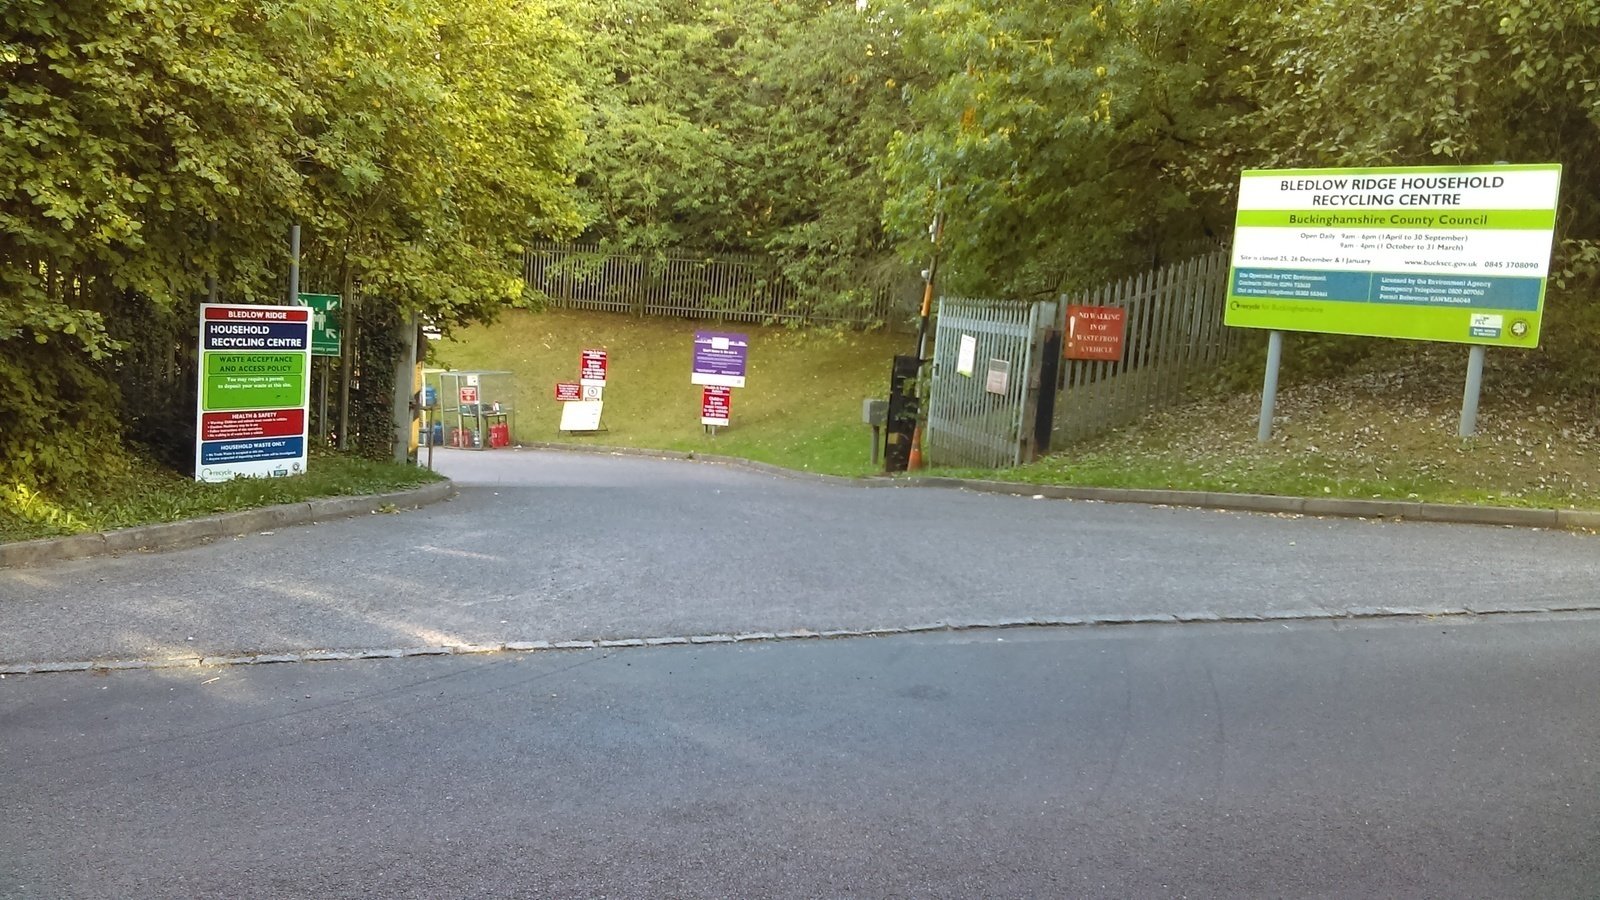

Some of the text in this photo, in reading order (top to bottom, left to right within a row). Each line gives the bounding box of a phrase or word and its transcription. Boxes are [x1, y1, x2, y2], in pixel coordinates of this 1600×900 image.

[1280, 176, 1504, 191] BLEDLOW RIDGE HOUSEHOLD
[1312, 193, 1461, 206] RECYCLING CENTRE
[1289, 214, 1488, 227] Buckinghamshire County Council
[1300, 232, 1318, 240] Open
[1424, 234, 1469, 242] September)
[1346, 257, 1371, 265] January
[1505, 261, 1539, 269] 3708090
[228, 311, 264, 319] BLEDLOW
[210, 325, 270, 335] HOUSEHOLD
[211, 338, 302, 347] RECYCLING CENTRE
[1077, 334, 1119, 343] WASTE FROM
[220, 443, 253, 451] HOUSEHOLD
[212, 468, 232, 477] recycle
